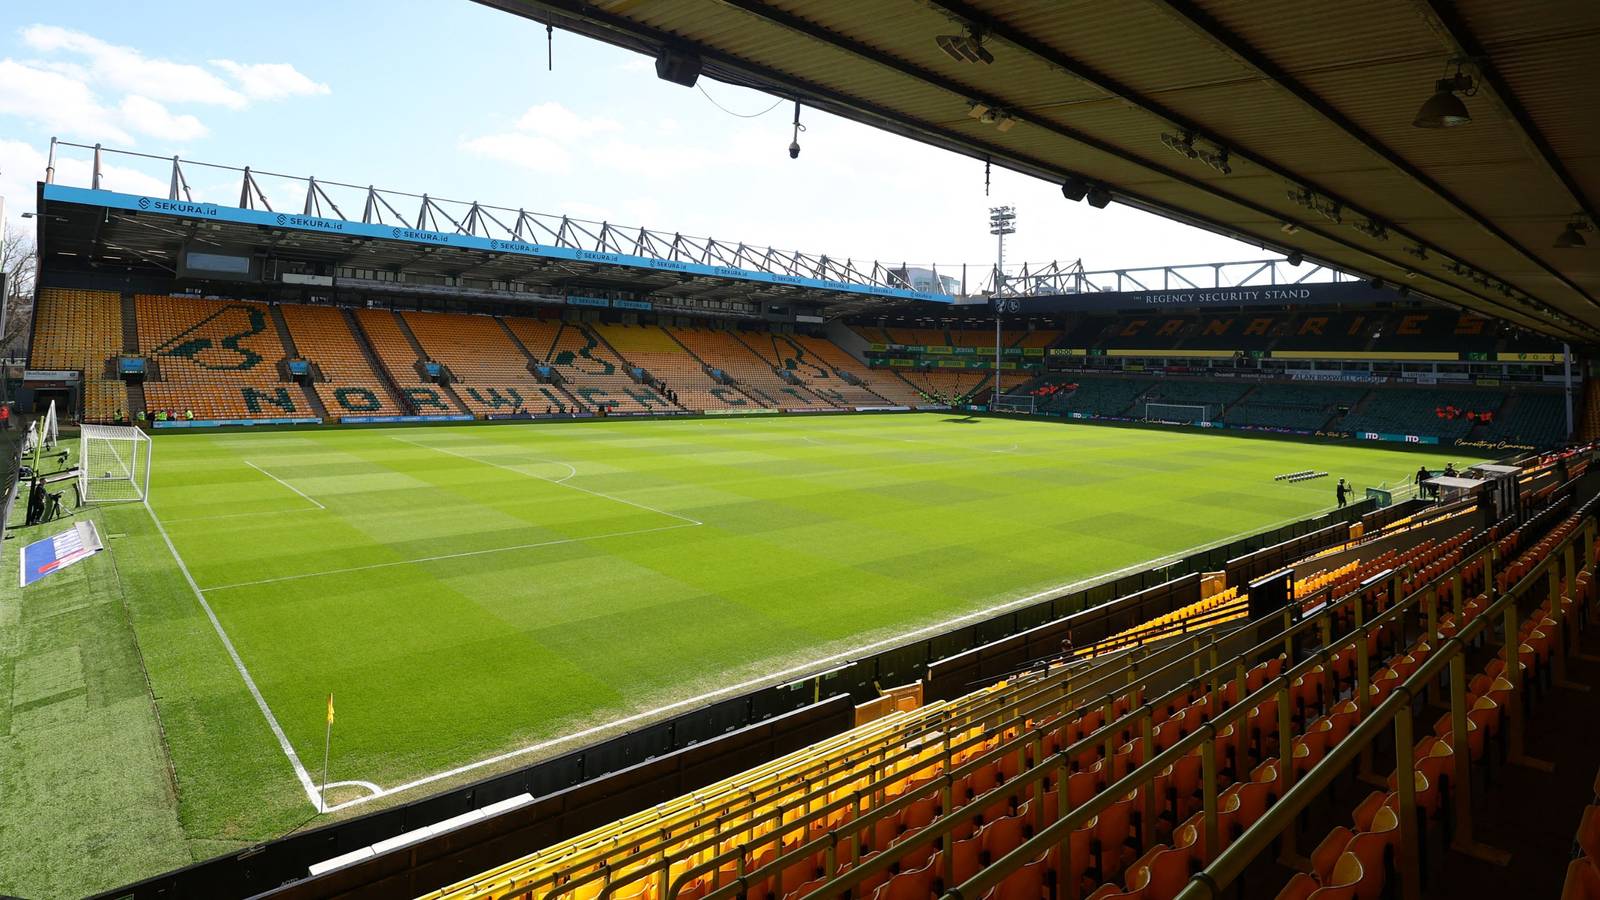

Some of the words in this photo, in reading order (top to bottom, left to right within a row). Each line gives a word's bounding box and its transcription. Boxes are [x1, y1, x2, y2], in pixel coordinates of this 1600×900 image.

[154, 200, 217, 216] SEKURA.id
[289, 216, 343, 230] SEKURA.id
[403, 230, 448, 242] SEKURA.id
[500, 242, 539, 253] SEKURA.id
[583, 252, 618, 262] SEKURA.id
[656, 260, 687, 270] SEKURA.id
[1146, 293, 1194, 304] REGENCY
[1199, 290, 1259, 302] SECURITY
[1264, 288, 1310, 300] STAND
[1365, 432, 1379, 440] ITD
[1405, 435, 1419, 443] ITD
